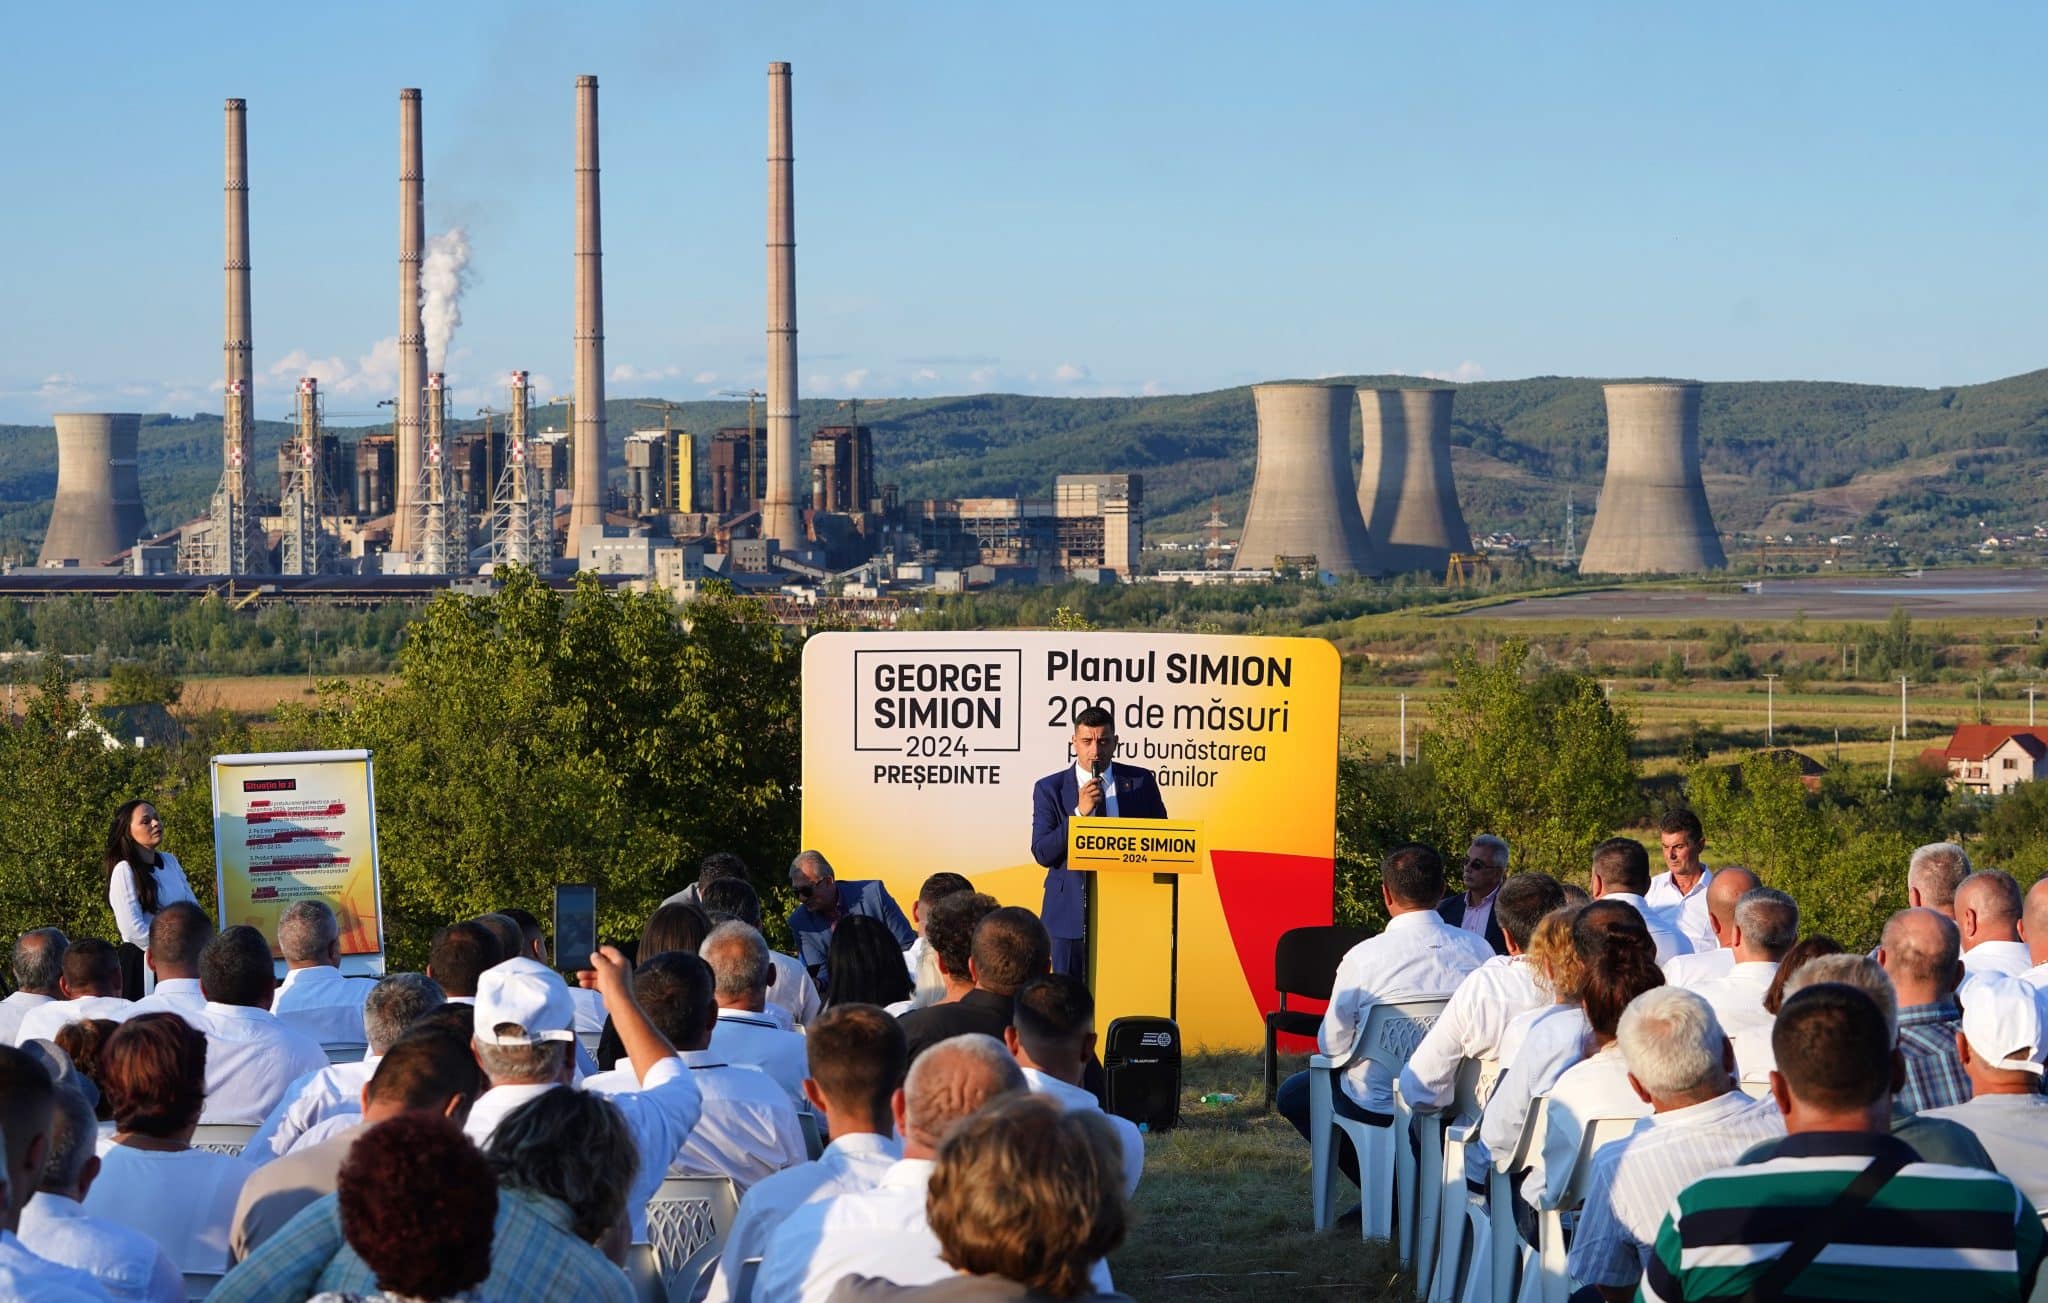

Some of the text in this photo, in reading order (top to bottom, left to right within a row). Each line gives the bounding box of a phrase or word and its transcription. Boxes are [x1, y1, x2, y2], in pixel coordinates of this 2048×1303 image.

[875, 664, 1001, 692] GEORGE
[1047, 649, 1292, 687] Planul SIMION
[875, 697, 1001, 729] SIMION
[1125, 696, 1164, 729] de
[1173, 698, 1289, 732] măsuri
[906, 736, 969, 757] 2024
[1144, 737, 1266, 762] bunăstarea
[874, 765, 1000, 791] PREȘEDINTE
[1075, 835, 1196, 853] GEORGE SIMION
[1122, 853, 1147, 863] 2024
